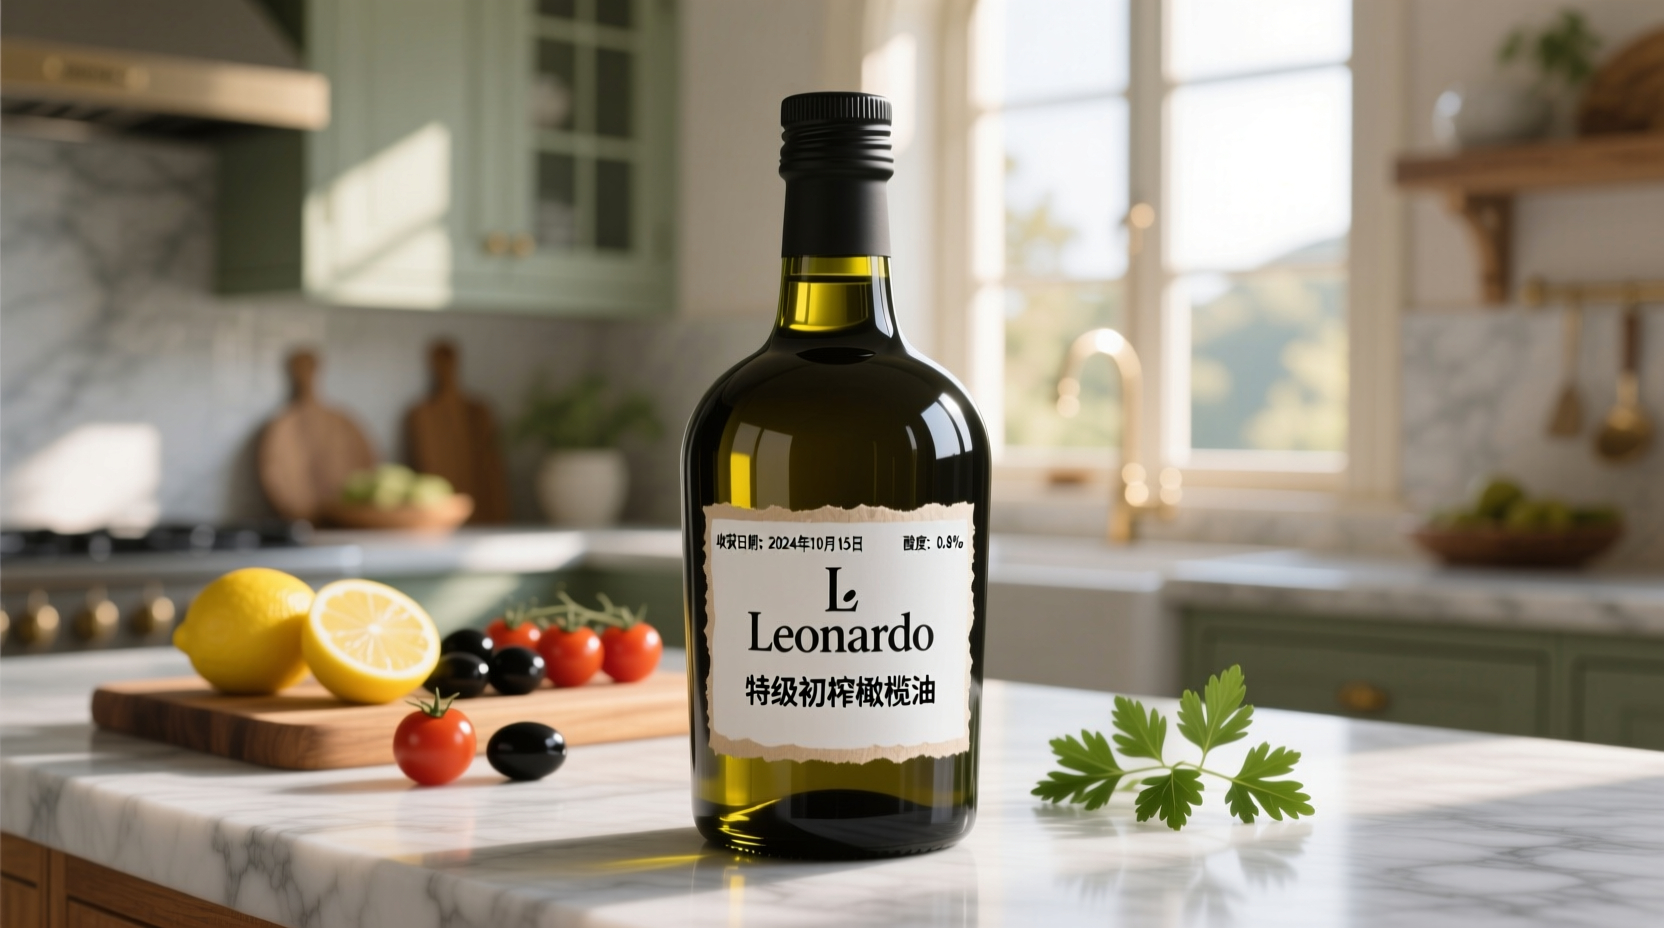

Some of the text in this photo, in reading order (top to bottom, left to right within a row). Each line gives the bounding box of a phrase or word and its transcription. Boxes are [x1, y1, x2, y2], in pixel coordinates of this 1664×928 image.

[825, 567, 858, 612] L
[748, 611, 934, 653] Leonardo
[746, 674, 936, 708] 特级初榨橄榄油
